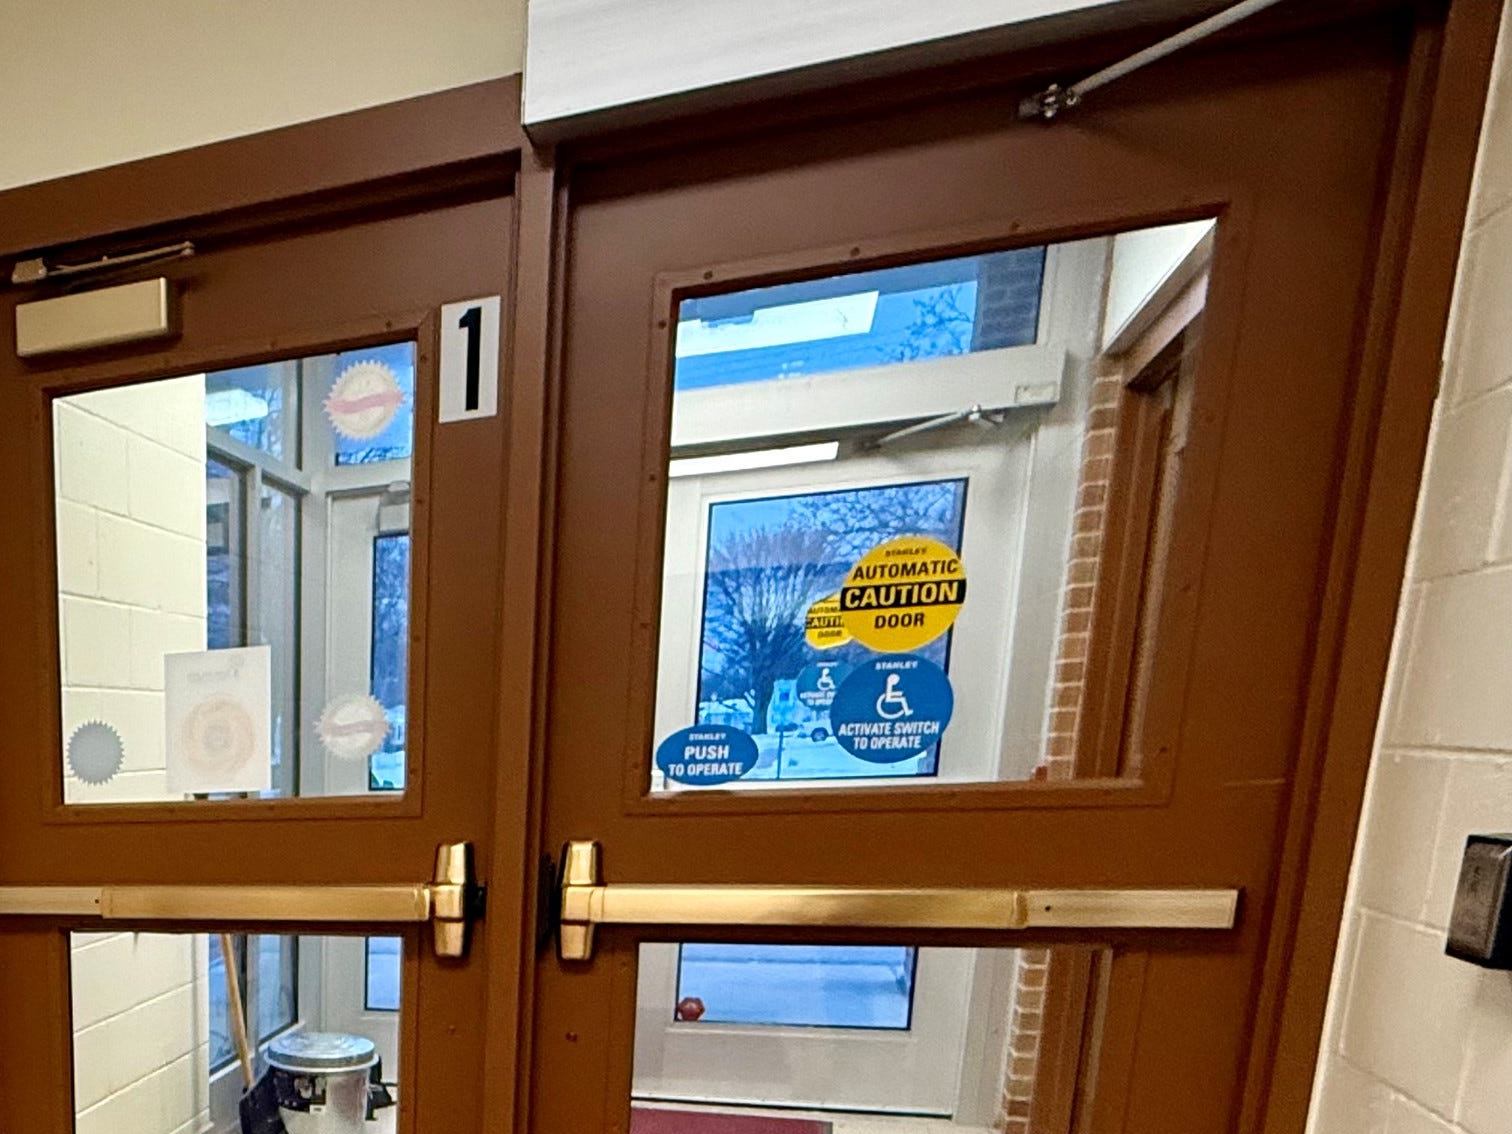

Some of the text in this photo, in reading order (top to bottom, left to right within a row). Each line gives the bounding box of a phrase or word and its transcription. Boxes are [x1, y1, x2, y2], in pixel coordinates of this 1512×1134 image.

[458, 306, 483, 411] 1
[885, 547, 927, 557] STANLEY
[853, 559, 959, 581] AUTOMATIC
[845, 581, 959, 608] CAUTION
[874, 612, 926, 629] DOOR
[875, 661, 919, 670] STANLEY
[838, 720, 940, 736] ACTIVATE SWITCH
[689, 732, 727, 742] STANLEY
[853, 735, 922, 750] TO OPERATE
[684, 744, 730, 760] PUSH
[668, 761, 744, 777] TO OPERATE
